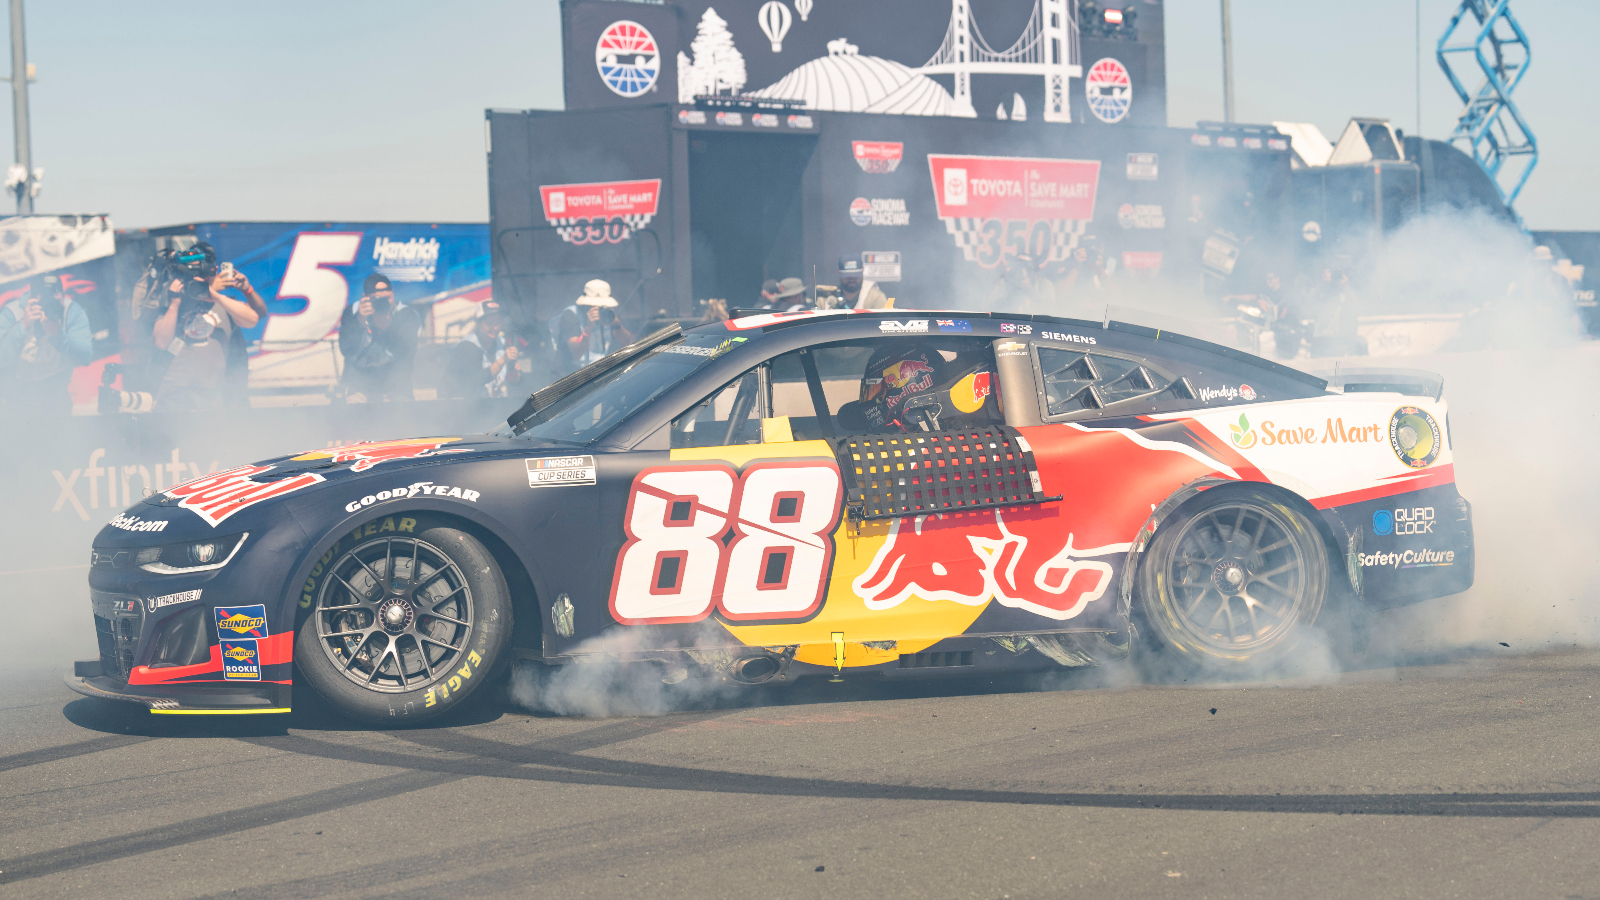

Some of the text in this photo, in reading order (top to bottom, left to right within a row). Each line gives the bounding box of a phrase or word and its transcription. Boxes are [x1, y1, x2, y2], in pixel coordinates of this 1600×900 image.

[970, 179, 1023, 197] TOYOTA
[1029, 182, 1090, 198] SAVE MART
[567, 195, 603, 207] TOYOTA
[608, 192, 653, 204] SAVE MART
[871, 198, 906, 212] SONOMA
[872, 212, 910, 226] RACEWAY
[570, 214, 627, 246] 350
[373, 237, 440, 265] Hendrick
[977, 218, 1053, 269] 350
[261, 231, 363, 350] 5
[1041, 331, 1096, 346] SIEMENS
[886, 374, 934, 409] Red Bull
[1198, 385, 1238, 401] Wendy's
[1260, 418, 1384, 446] Save Mart
[547, 458, 584, 468] NASCAR
[537, 469, 586, 481] CUP SERIES
[345, 482, 481, 513] GOODYEAR
[1395, 507, 1435, 524] QUAD
[1396, 520, 1434, 536] LOCK
[609, 462, 842, 624] 88
[1357, 548, 1455, 569] SafetyCulture
[157, 590, 197, 608] TRACKHOUSE
[220, 618, 262, 628] SUNOCO
[424, 648, 482, 708] EAGLE
